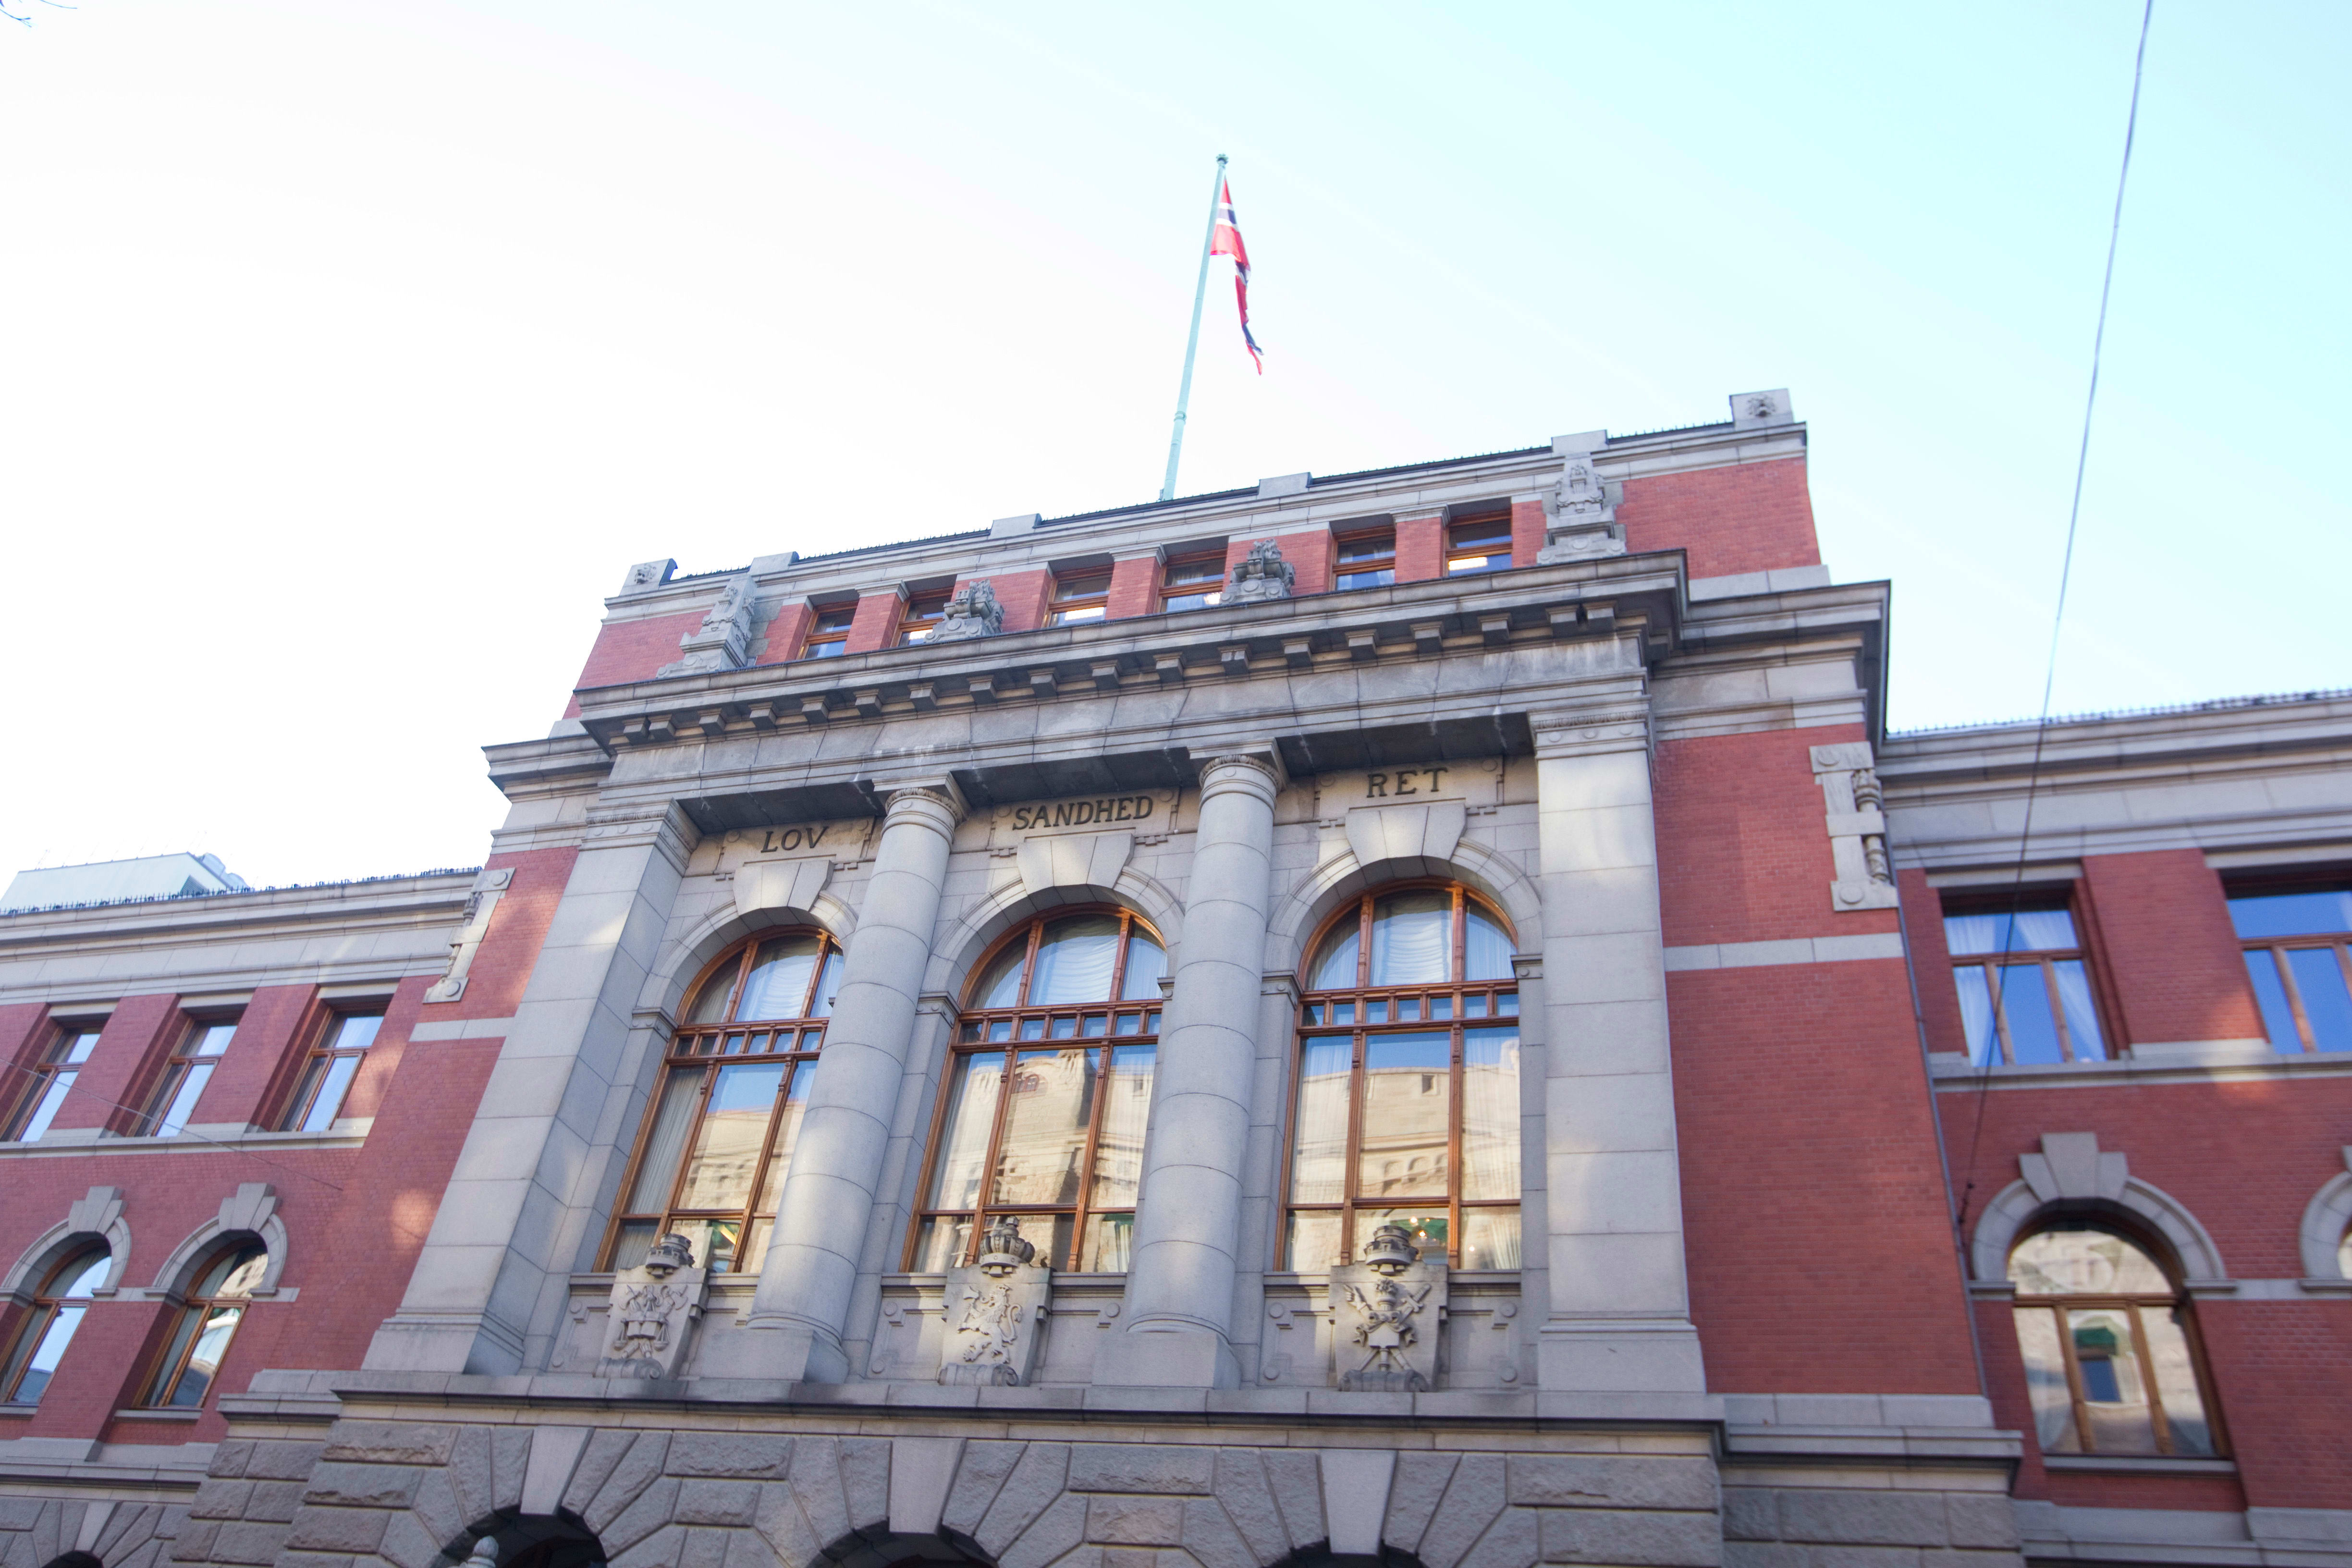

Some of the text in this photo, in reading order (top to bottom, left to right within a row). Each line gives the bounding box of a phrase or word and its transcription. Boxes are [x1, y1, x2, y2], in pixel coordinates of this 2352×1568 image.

[1367, 767, 1448, 798] RET
[1012, 796, 1153, 831] SANDHED
[761, 826, 829, 853] LOV
